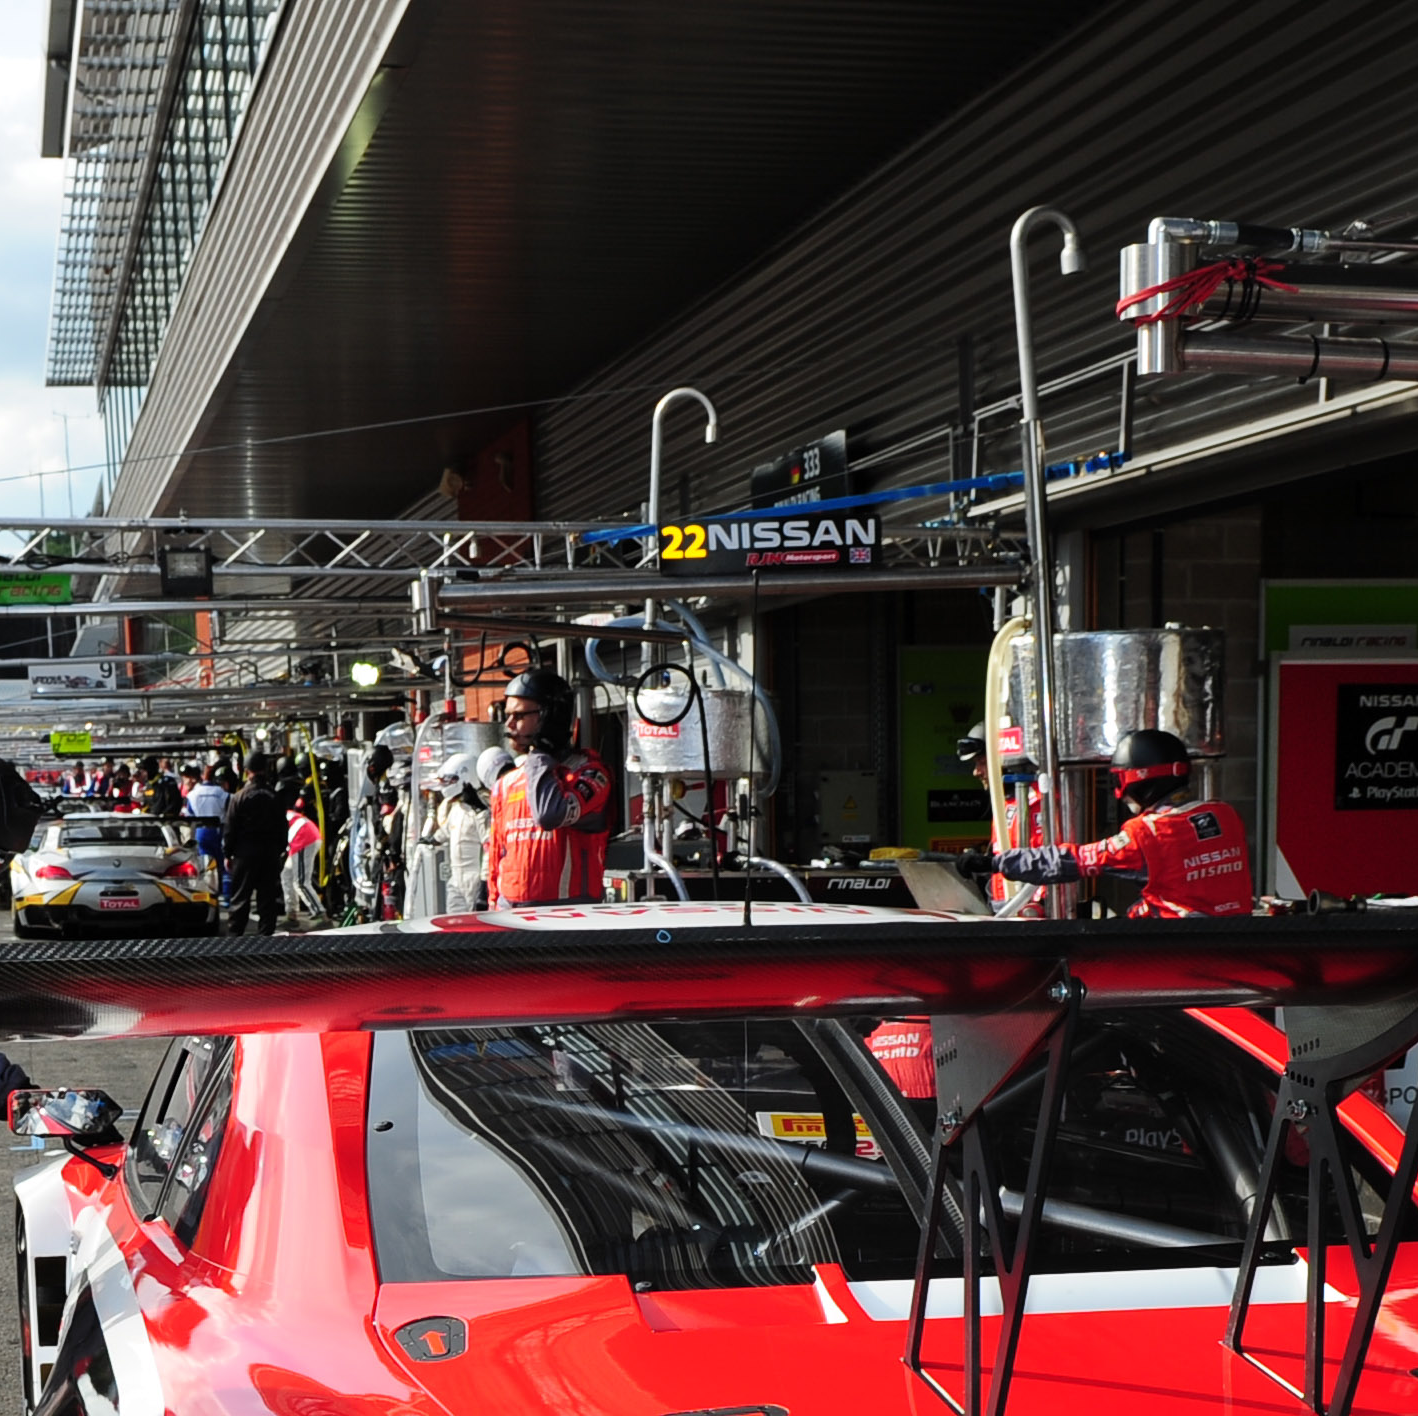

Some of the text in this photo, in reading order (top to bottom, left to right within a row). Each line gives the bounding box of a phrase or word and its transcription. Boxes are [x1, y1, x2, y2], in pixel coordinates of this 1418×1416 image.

[803, 448, 821, 480] 333
[661, 519, 875, 559] 22 NISSAN
[746, 552, 781, 566] RJN
[638, 724, 677, 736] TOTAL
[1184, 847, 1241, 868] NISSAN
[1186, 862, 1243, 882] nismo
[103, 900, 139, 909] TOTAL
